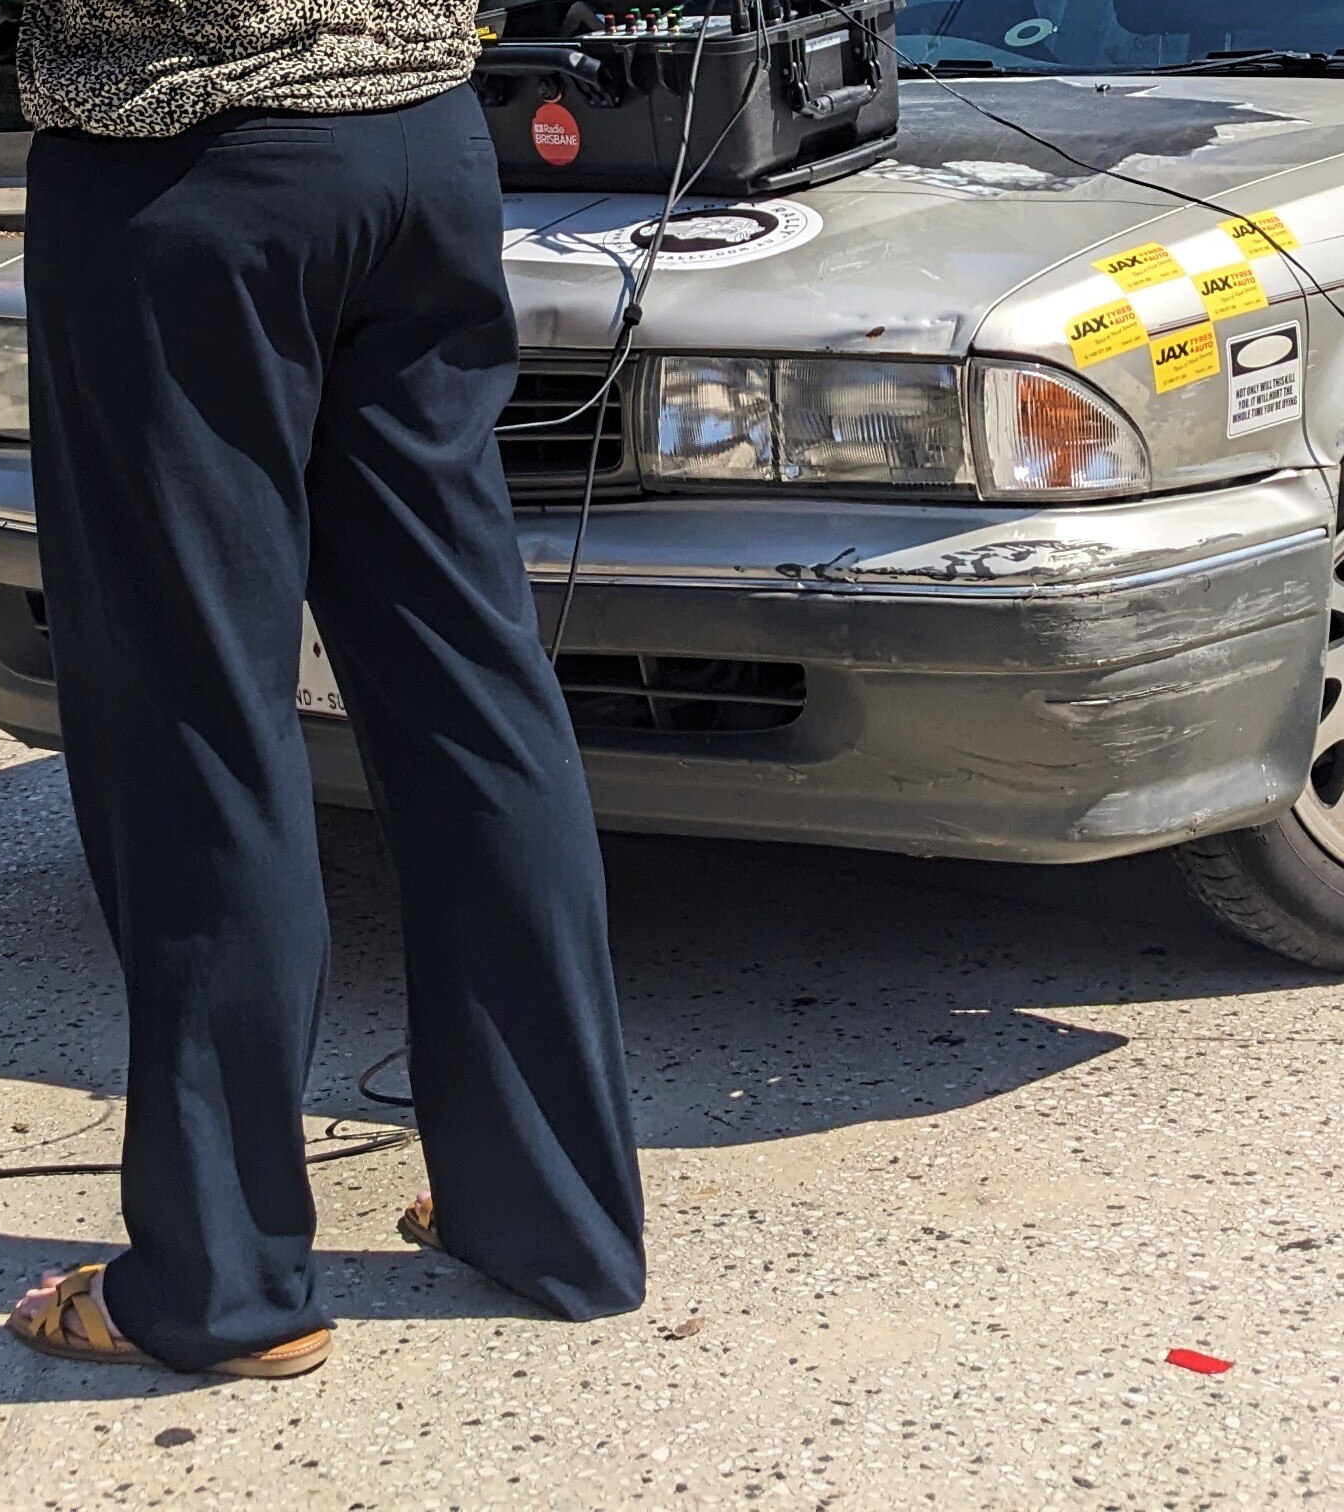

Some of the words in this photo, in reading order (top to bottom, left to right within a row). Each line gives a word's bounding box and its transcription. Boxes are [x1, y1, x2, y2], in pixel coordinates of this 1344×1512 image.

[543, 123, 565, 134] Radio
[535, 134, 578, 146] BRISBANE
[771, 206, 800, 239] RALLY
[1107, 255, 1145, 274] JAX
[1201, 275, 1234, 296] JAX
[1230, 269, 1253, 281] TYRES
[1237, 276, 1256, 287] AUTO
[1070, 314, 1110, 341] JAX
[1106, 304, 1132, 319] TYRES
[1114, 312, 1136, 325] AUTO
[1155, 339, 1190, 366] JAX
[1189, 332, 1213, 346] TYRES
[1194, 341, 1214, 354] AUTO
[1236, 386, 1247, 399] NOT
[1246, 382, 1260, 396] ONLY
[1260, 380, 1273, 392] WILL
[1272, 375, 1285, 387] THIS
[1284, 373, 1296, 385] KILL
[1232, 409, 1251, 424] WHOLE
